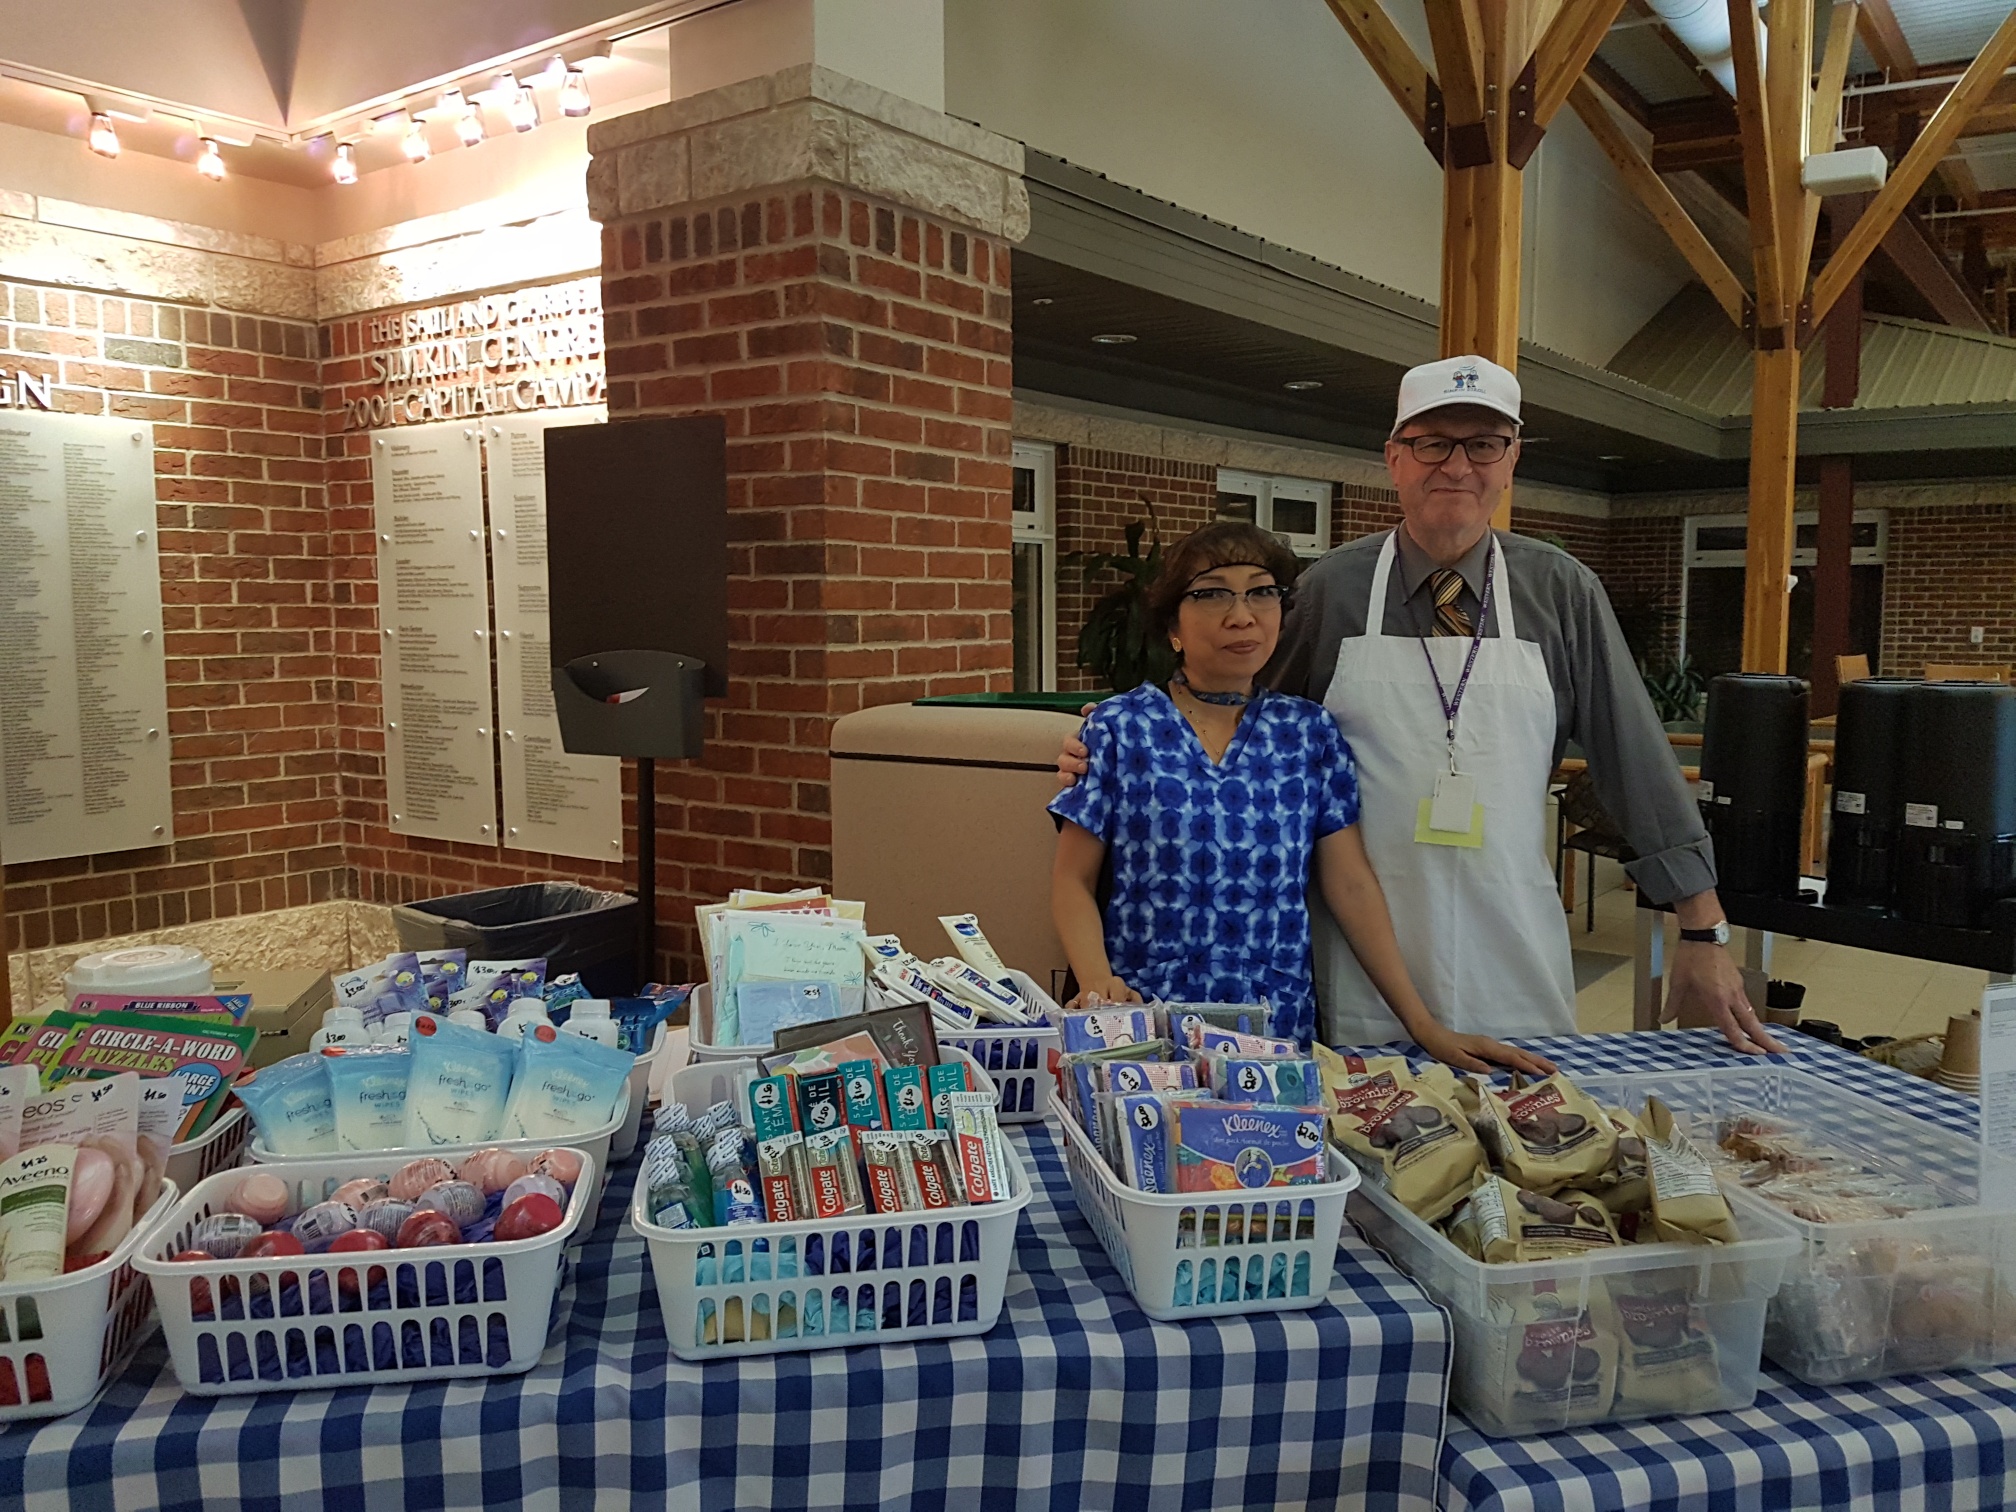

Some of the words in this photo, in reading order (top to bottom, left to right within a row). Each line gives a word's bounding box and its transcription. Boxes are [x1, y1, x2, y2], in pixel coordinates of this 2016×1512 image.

[369, 316, 401, 343] THE
[371, 340, 468, 385] SIMKIN
[344, 393, 396, 432] 2001
[1453, 677, 1467, 706] WESTERN
[156, 1002, 189, 1010] RIBBON
[89, 1029, 237, 1062] CIRCLE-A-WORD
[79, 1047, 177, 1073] PUZZLES
[185, 1083, 211, 1096] INT
[359, 1090, 390, 1102] fresh
[438, 1074, 467, 1089] fresh
[475, 1082, 489, 1092] go
[541, 1080, 570, 1097] fresh
[577, 1091, 592, 1102] go
[22, 1099, 65, 1120] eos
[1339, 1086, 1396, 1109] brownies
[1515, 1092, 1561, 1120] rownies
[286, 1103, 317, 1122] fresh
[764, 1110, 773, 1141] SANT
[1221, 1113, 1280, 1139] Kleenex
[1297, 1122, 1319, 1143] $2.00
[0, 1166, 69, 1187] Aveeno
[966, 1141, 985, 1197] Colgate
[1144, 1139, 1157, 1194] leenex
[820, 1170, 837, 1213] Colgate
[877, 1169, 895, 1213] Colgate
[922, 1165, 942, 1206] Colgate
